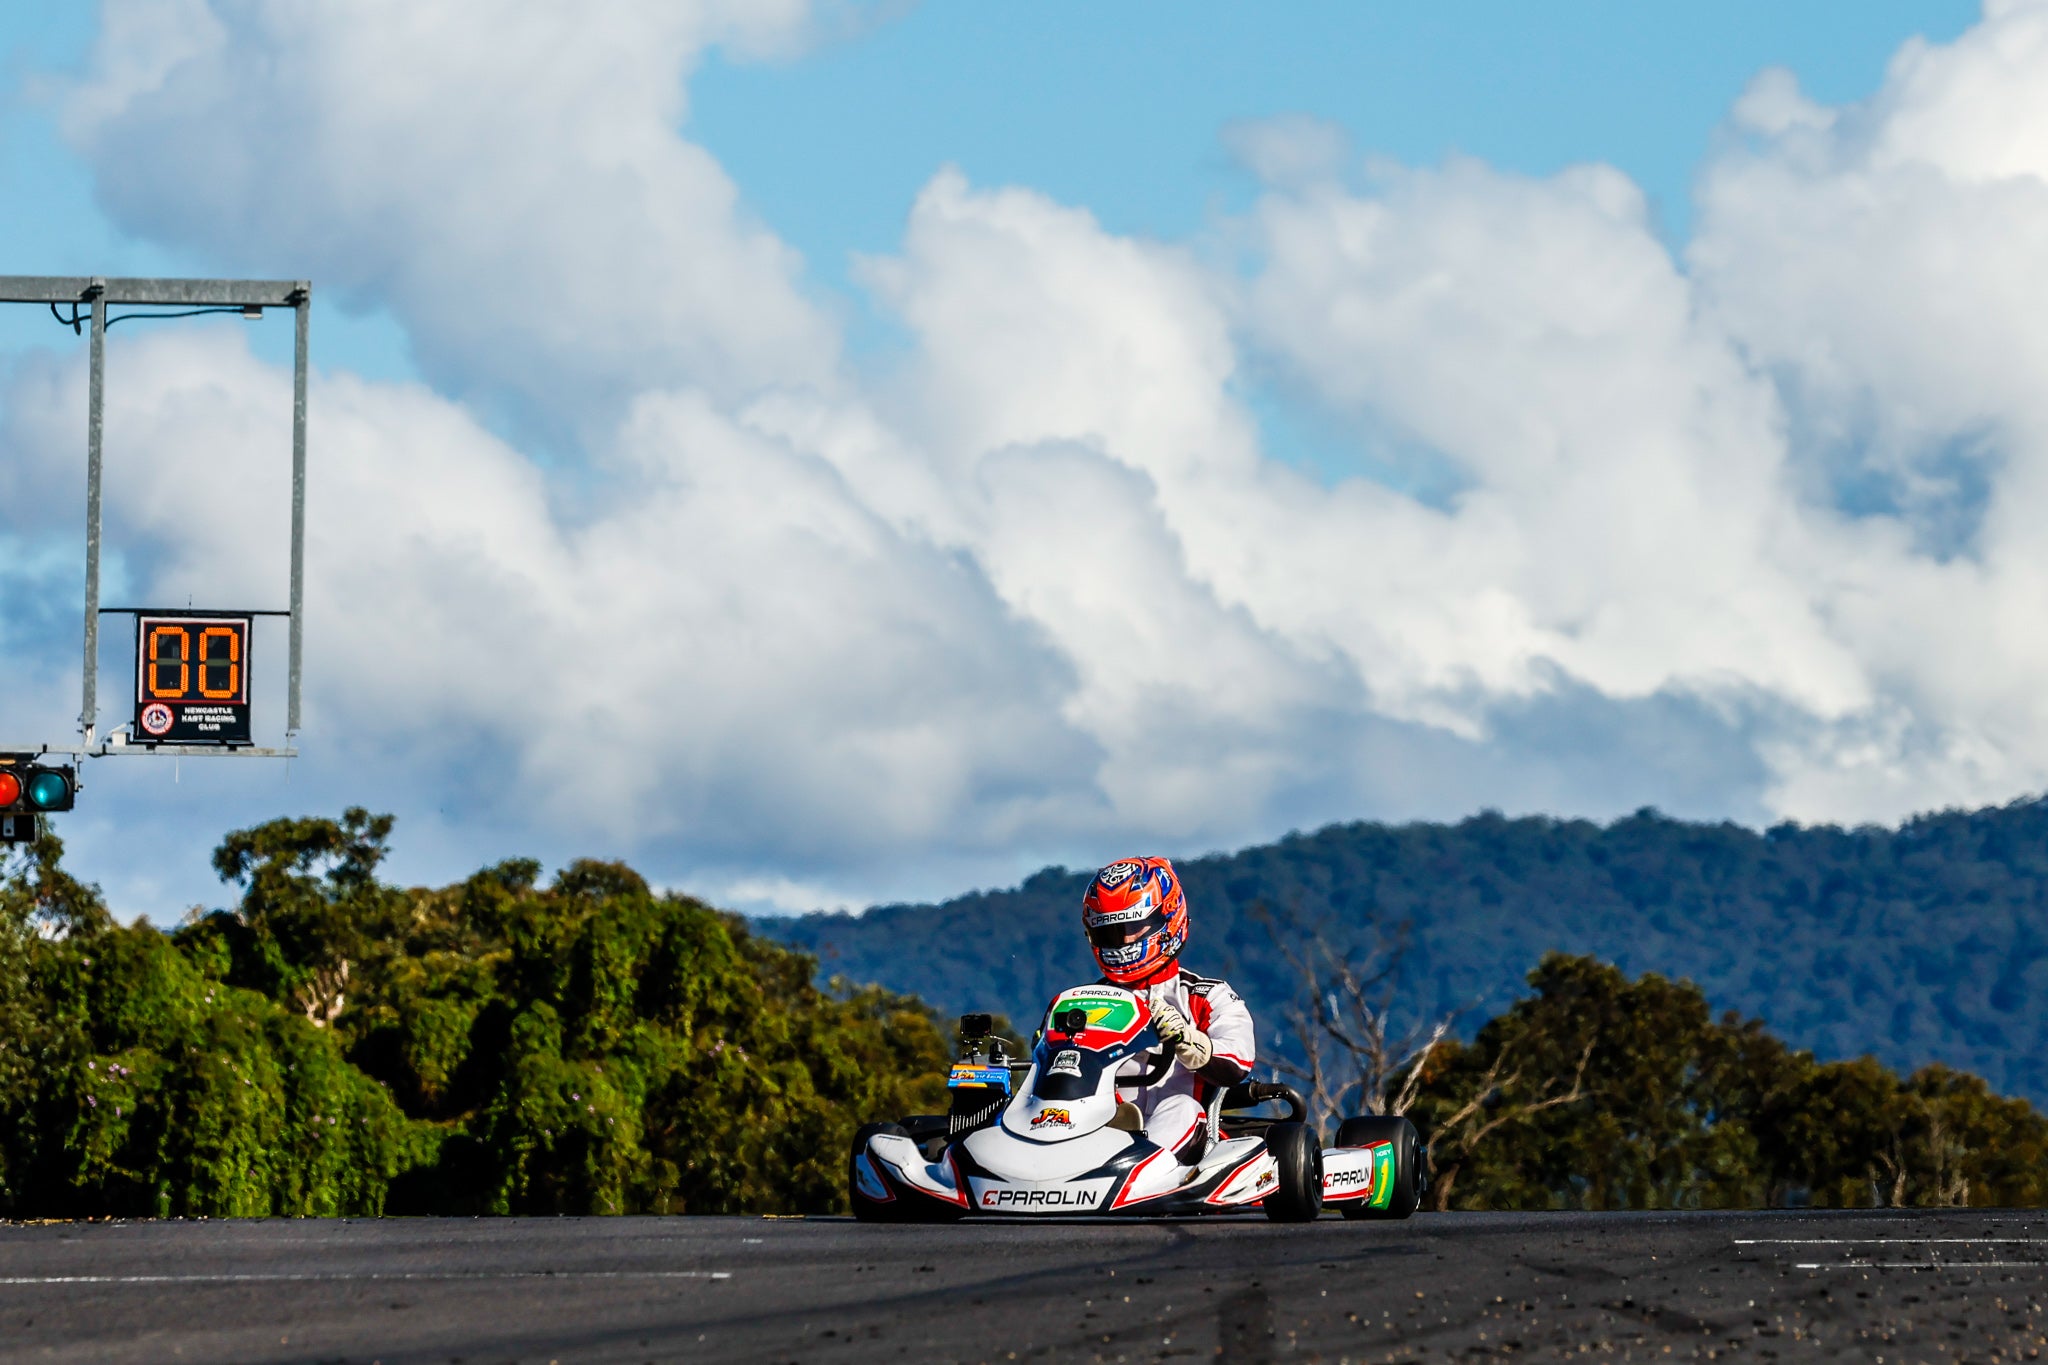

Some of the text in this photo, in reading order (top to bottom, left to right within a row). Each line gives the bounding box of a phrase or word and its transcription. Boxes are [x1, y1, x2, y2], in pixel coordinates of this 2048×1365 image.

[184, 706, 233, 715] NEWCASTLE
[181, 714, 237, 723] KART RACING
[198, 723, 221, 731] CLUB
